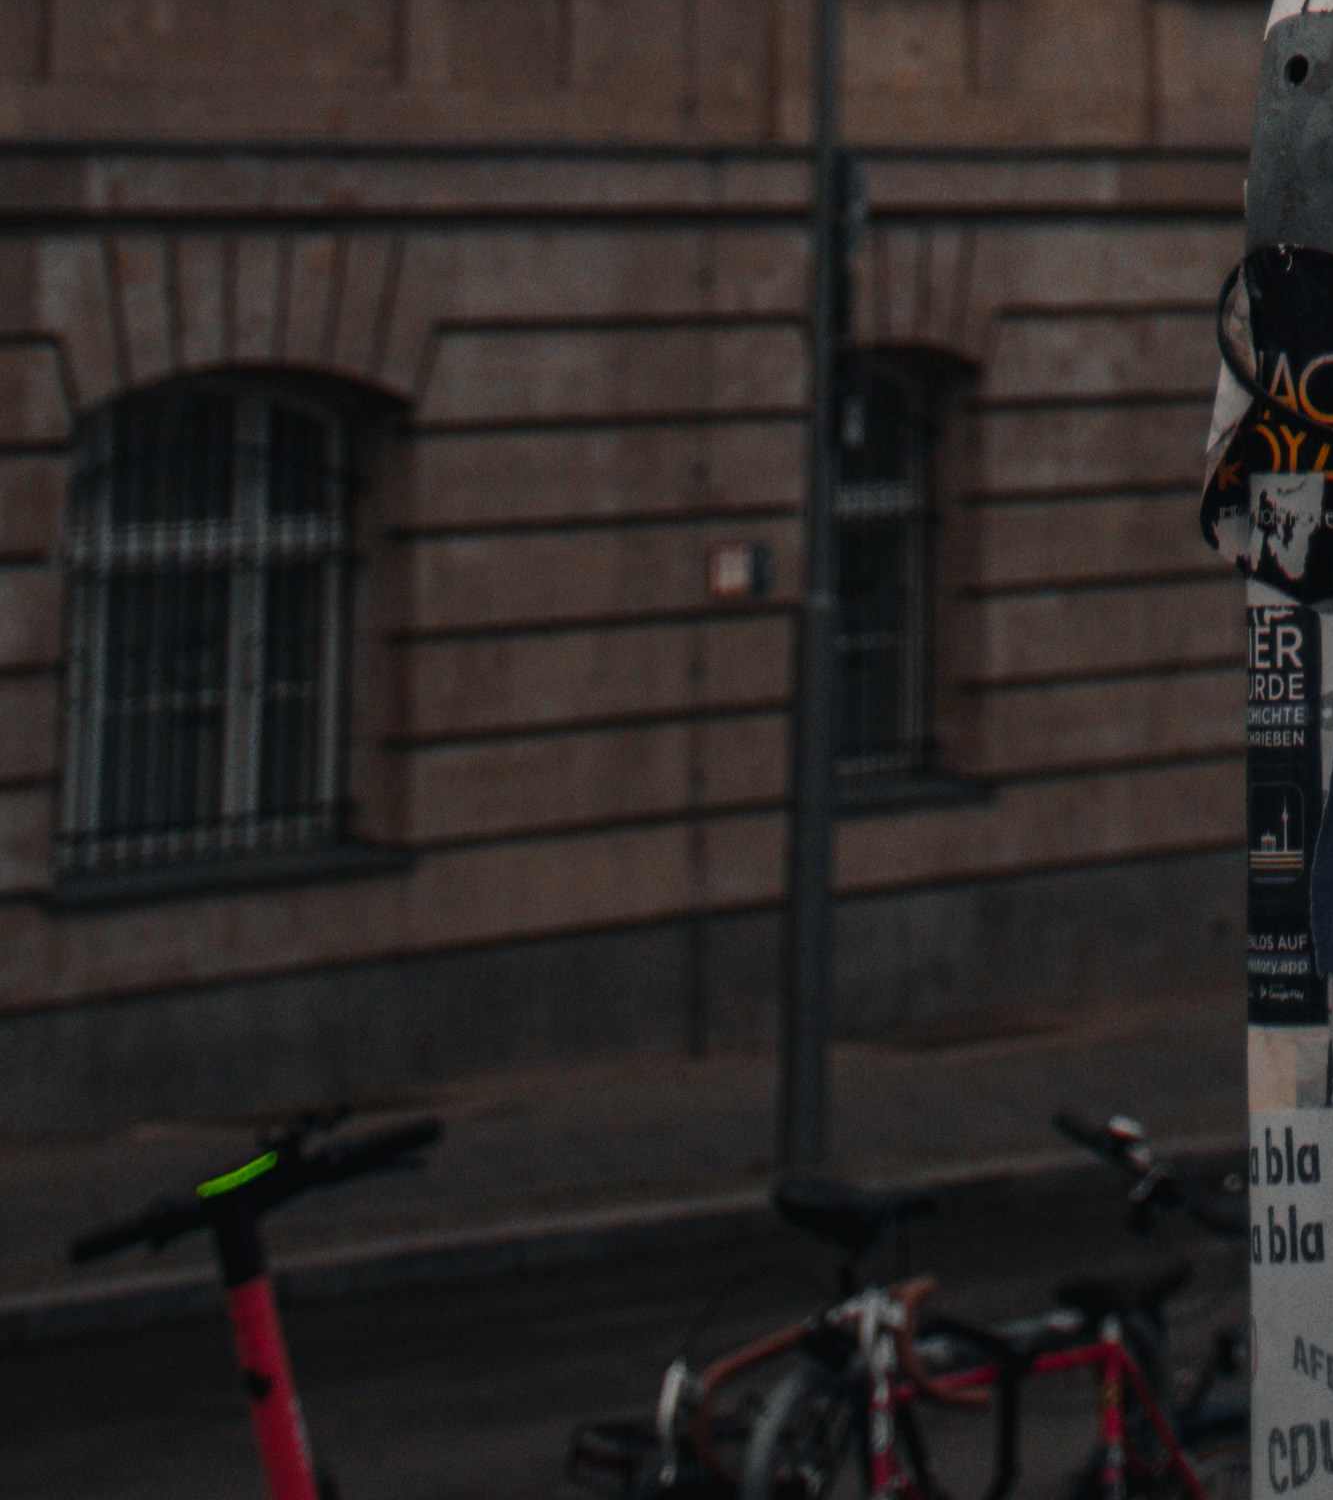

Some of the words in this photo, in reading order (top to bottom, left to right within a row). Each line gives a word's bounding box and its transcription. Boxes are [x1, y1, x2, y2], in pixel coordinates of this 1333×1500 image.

[1277, 933, 1308, 952] AUF
[1264, 1126, 1322, 1186] bla
[1267, 1205, 1325, 1265] bla
